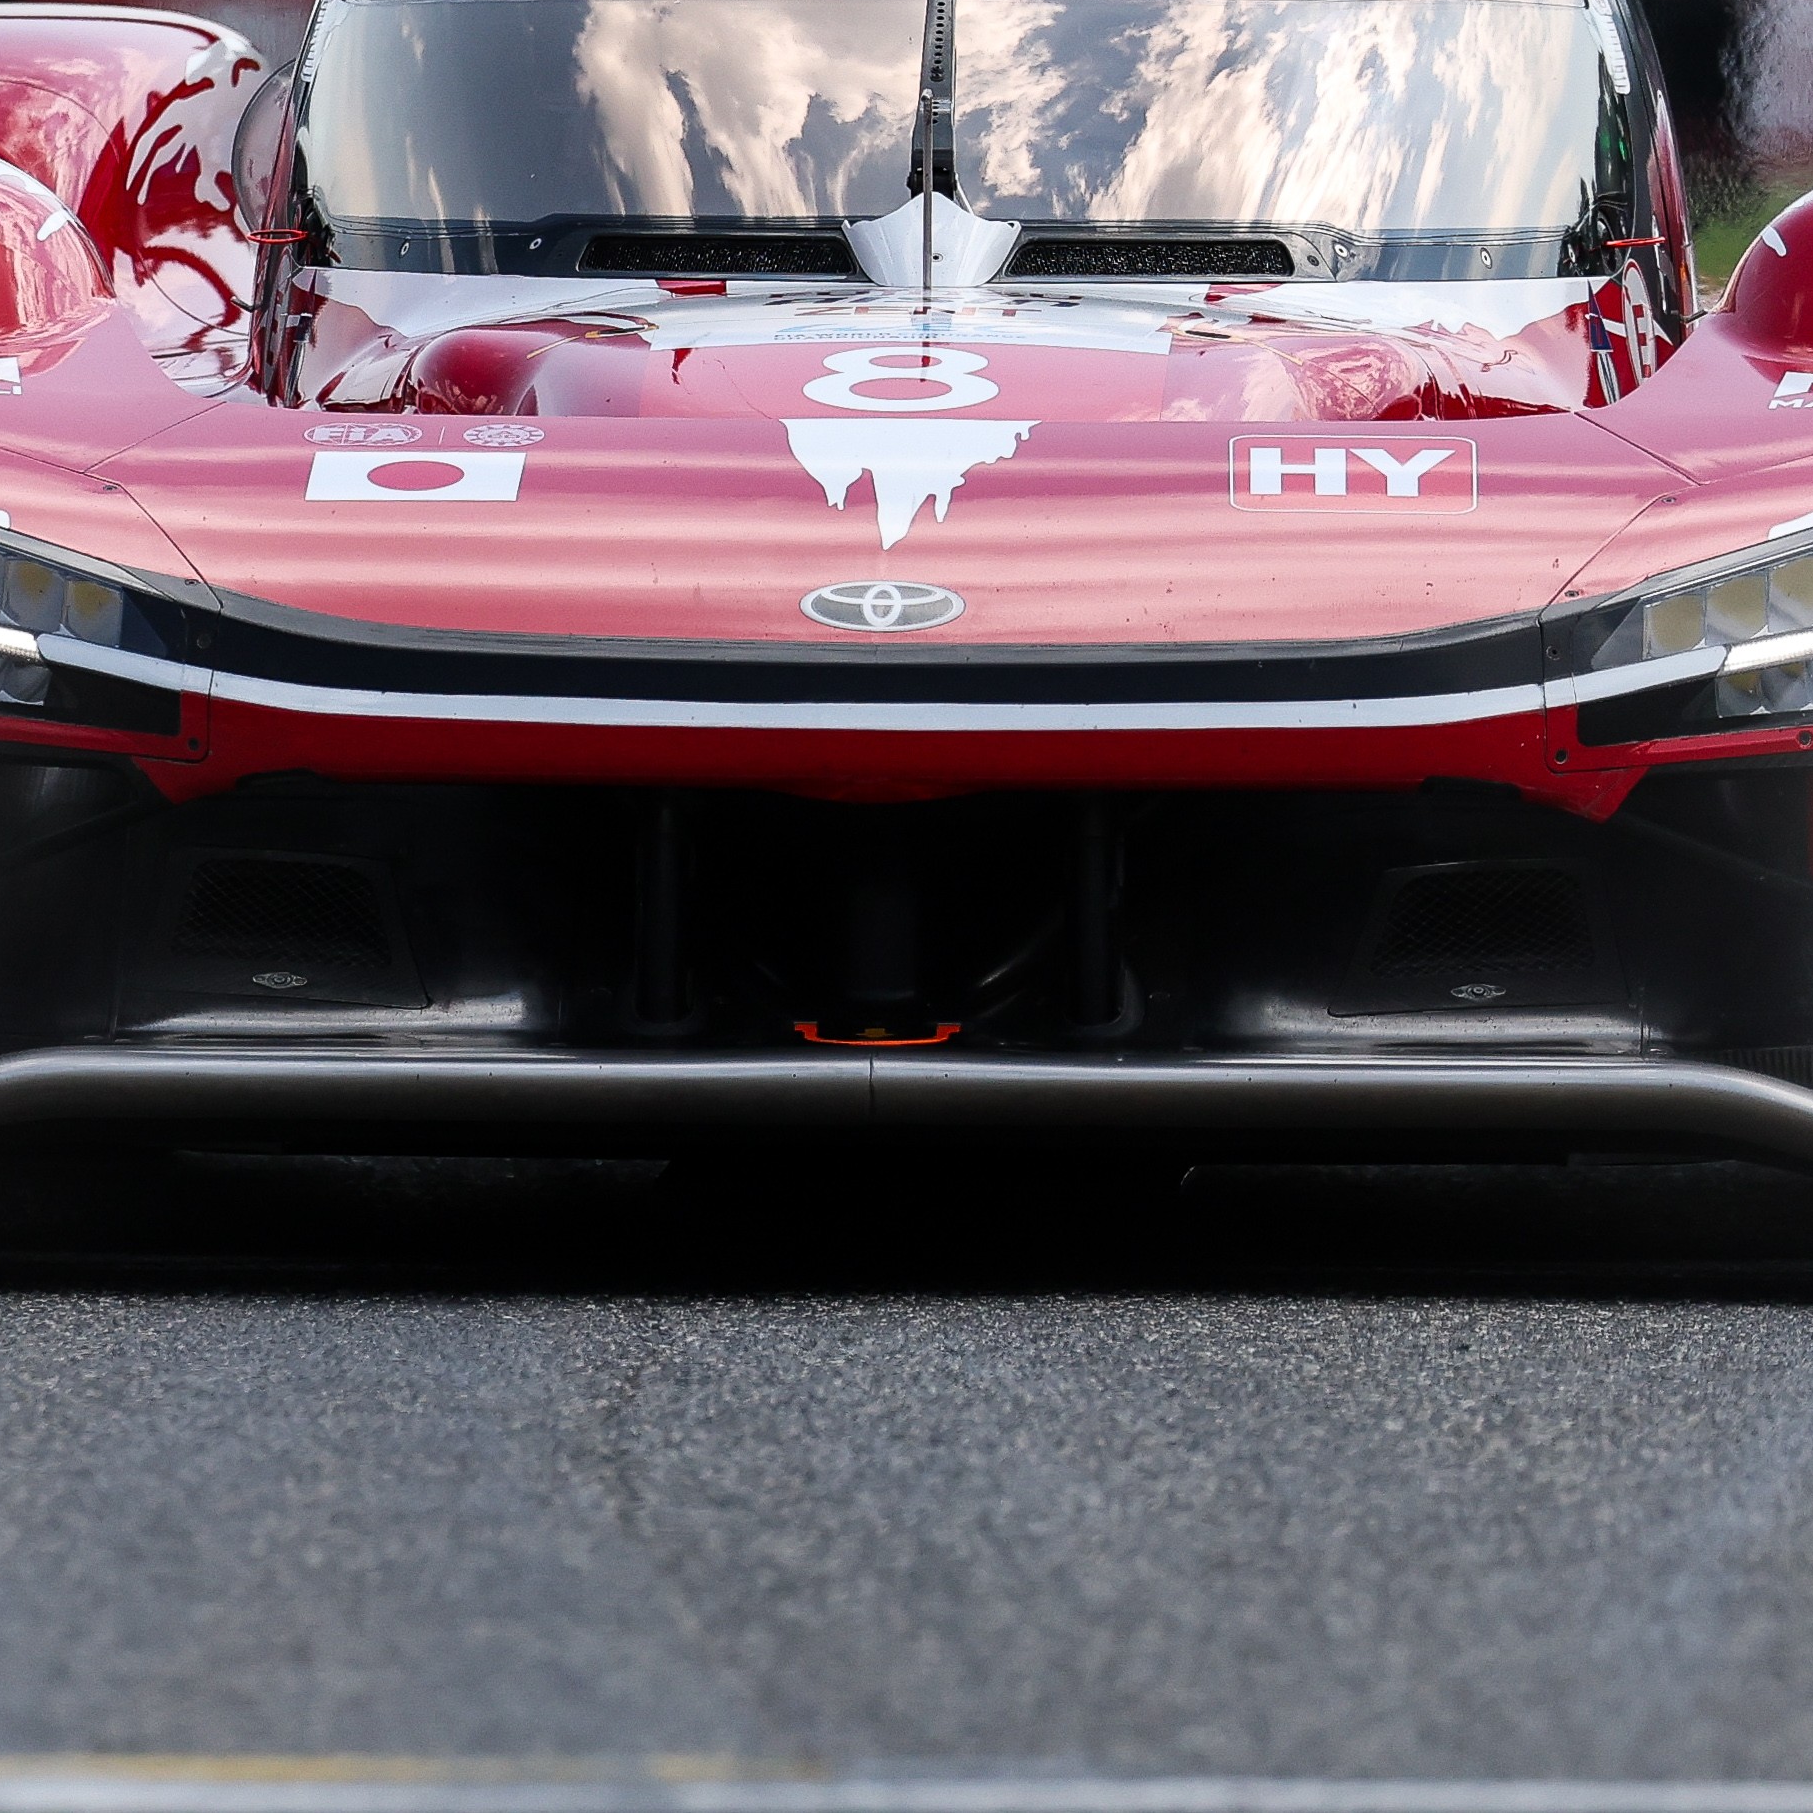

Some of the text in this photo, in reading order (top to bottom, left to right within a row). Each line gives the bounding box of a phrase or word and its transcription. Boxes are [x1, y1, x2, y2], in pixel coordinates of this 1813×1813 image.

[801, 346, 1001, 412] 8
[312, 426, 410, 443] FIA
[1248, 447, 1456, 497] HY
